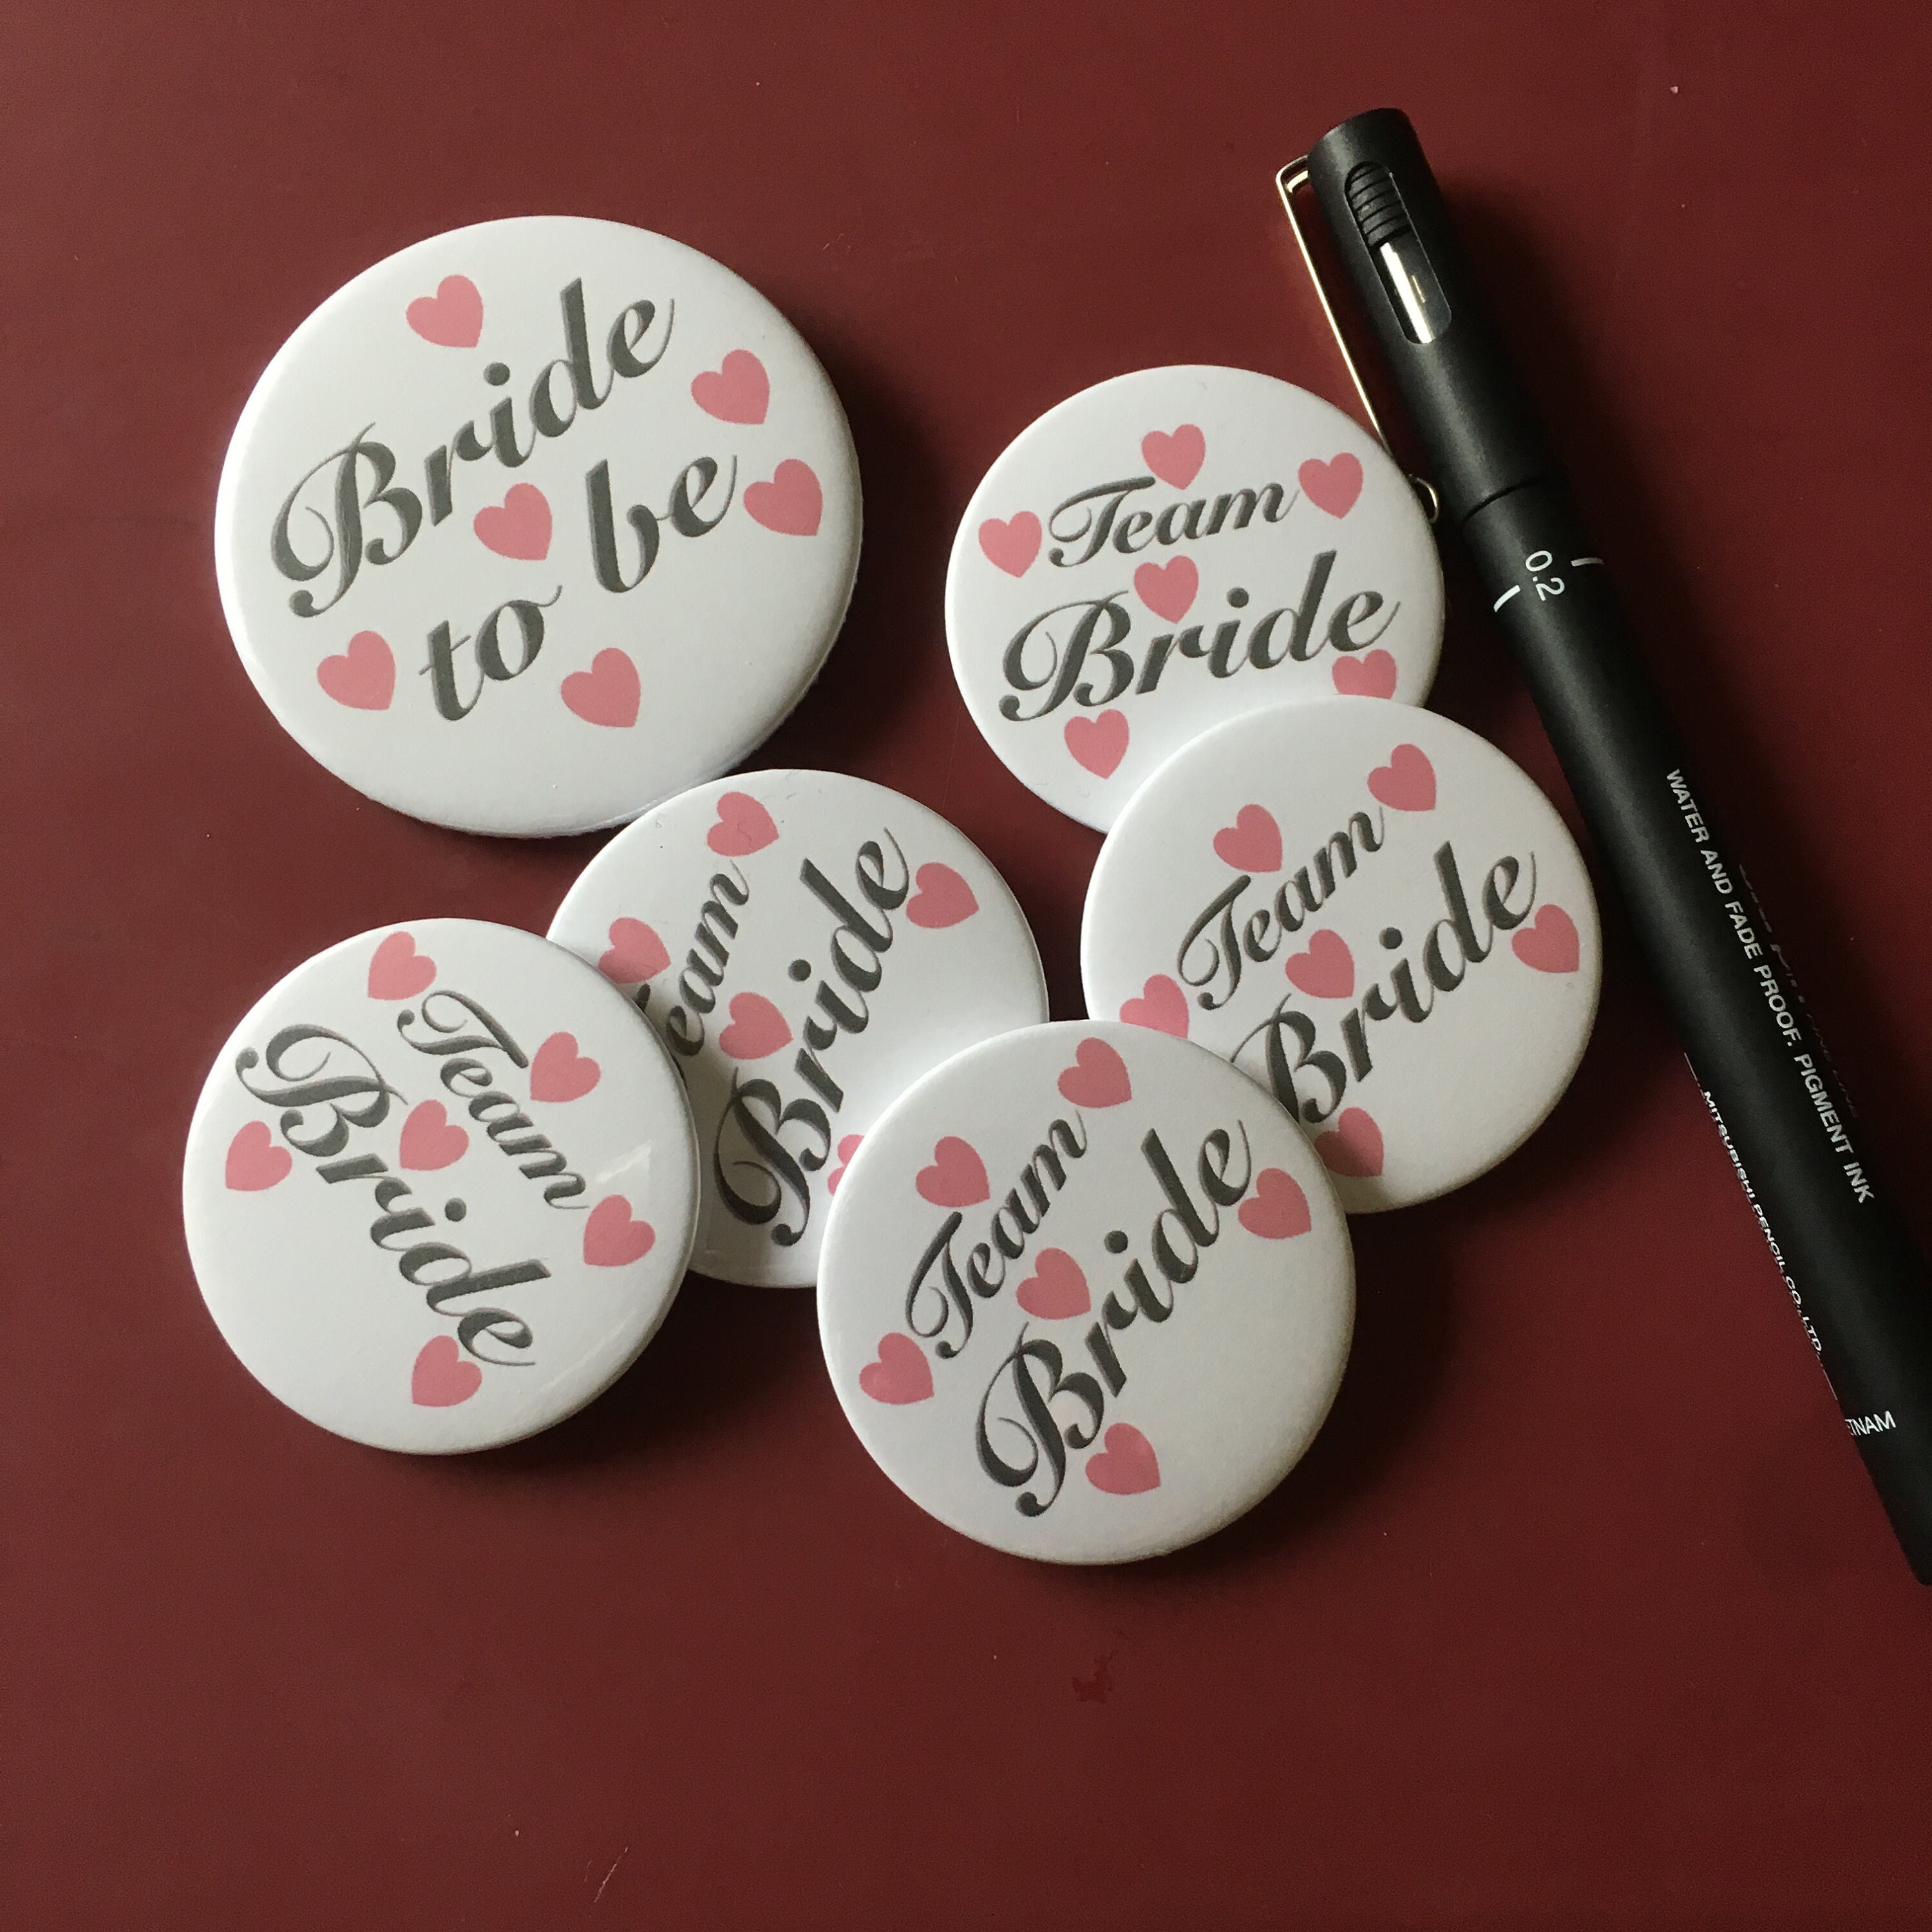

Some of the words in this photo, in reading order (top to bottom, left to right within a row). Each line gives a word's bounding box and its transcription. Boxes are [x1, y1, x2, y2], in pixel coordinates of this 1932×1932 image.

[270, 278, 674, 618] Bride
[1048, 476, 1300, 567] Team
[420, 585, 562, 721] to
[585, 454, 737, 593] be
[998, 550, 1400, 722] Bride
[1526, 551, 1565, 601] 0.2
[634, 860, 750, 1090] eam
[1177, 805, 1385, 1010] Team
[1229, 840, 1537, 1124] Bride
[1667, 769, 1710, 843] WATER
[1701, 849, 1734, 895] AND
[1725, 900, 1763, 960] FADE
[1754, 965, 1803, 1047] PROOF.
[1794, 1053, 1855, 1154] PIGMENT
[1843, 1161, 1875, 1204] INK
[397, 989, 590, 1209] Team
[714, 827, 910, 1247] Bride
[236, 1023, 552, 1367] Bride
[905, 1110, 1087, 1359] Team
[1704, 1091, 1756, 1199] MITSUBISHI
[1754, 1204, 1786, 1274] PENCIL
[976, 1120, 1251, 1517] Bride
[1844, 1410, 1897, 1437] TNAM
